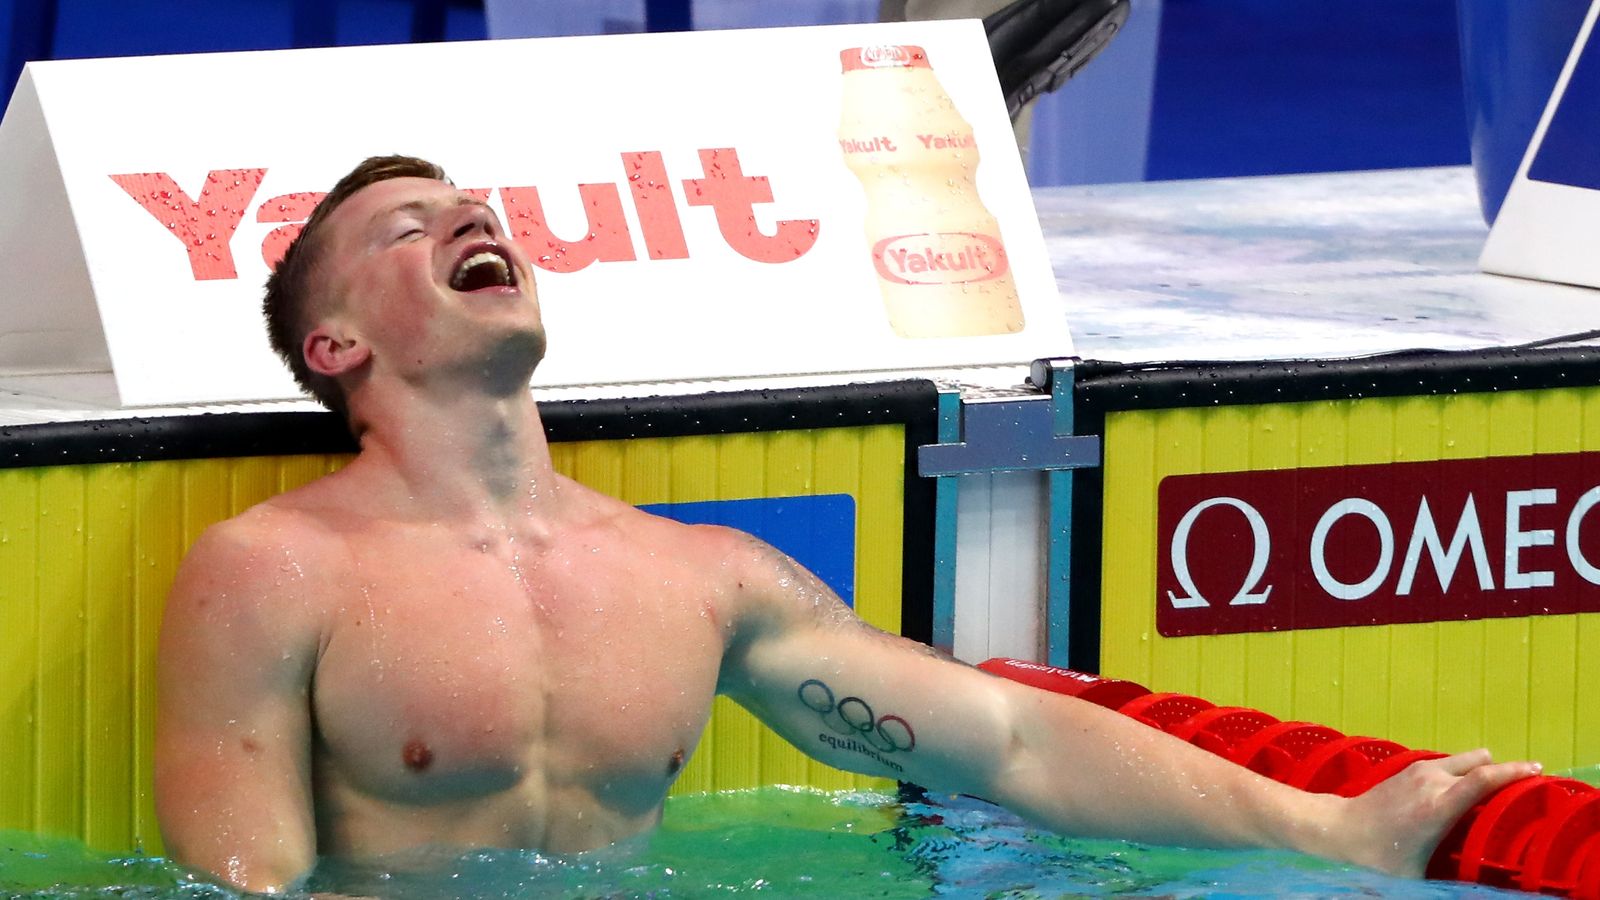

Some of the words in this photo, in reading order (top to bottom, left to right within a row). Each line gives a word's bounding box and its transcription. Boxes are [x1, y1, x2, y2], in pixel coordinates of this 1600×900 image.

[838, 135, 897, 154] Yakult
[108, 147, 821, 280] Yult
[888, 247, 990, 273] Yakult
[818, 732, 904, 773] equilibrium
